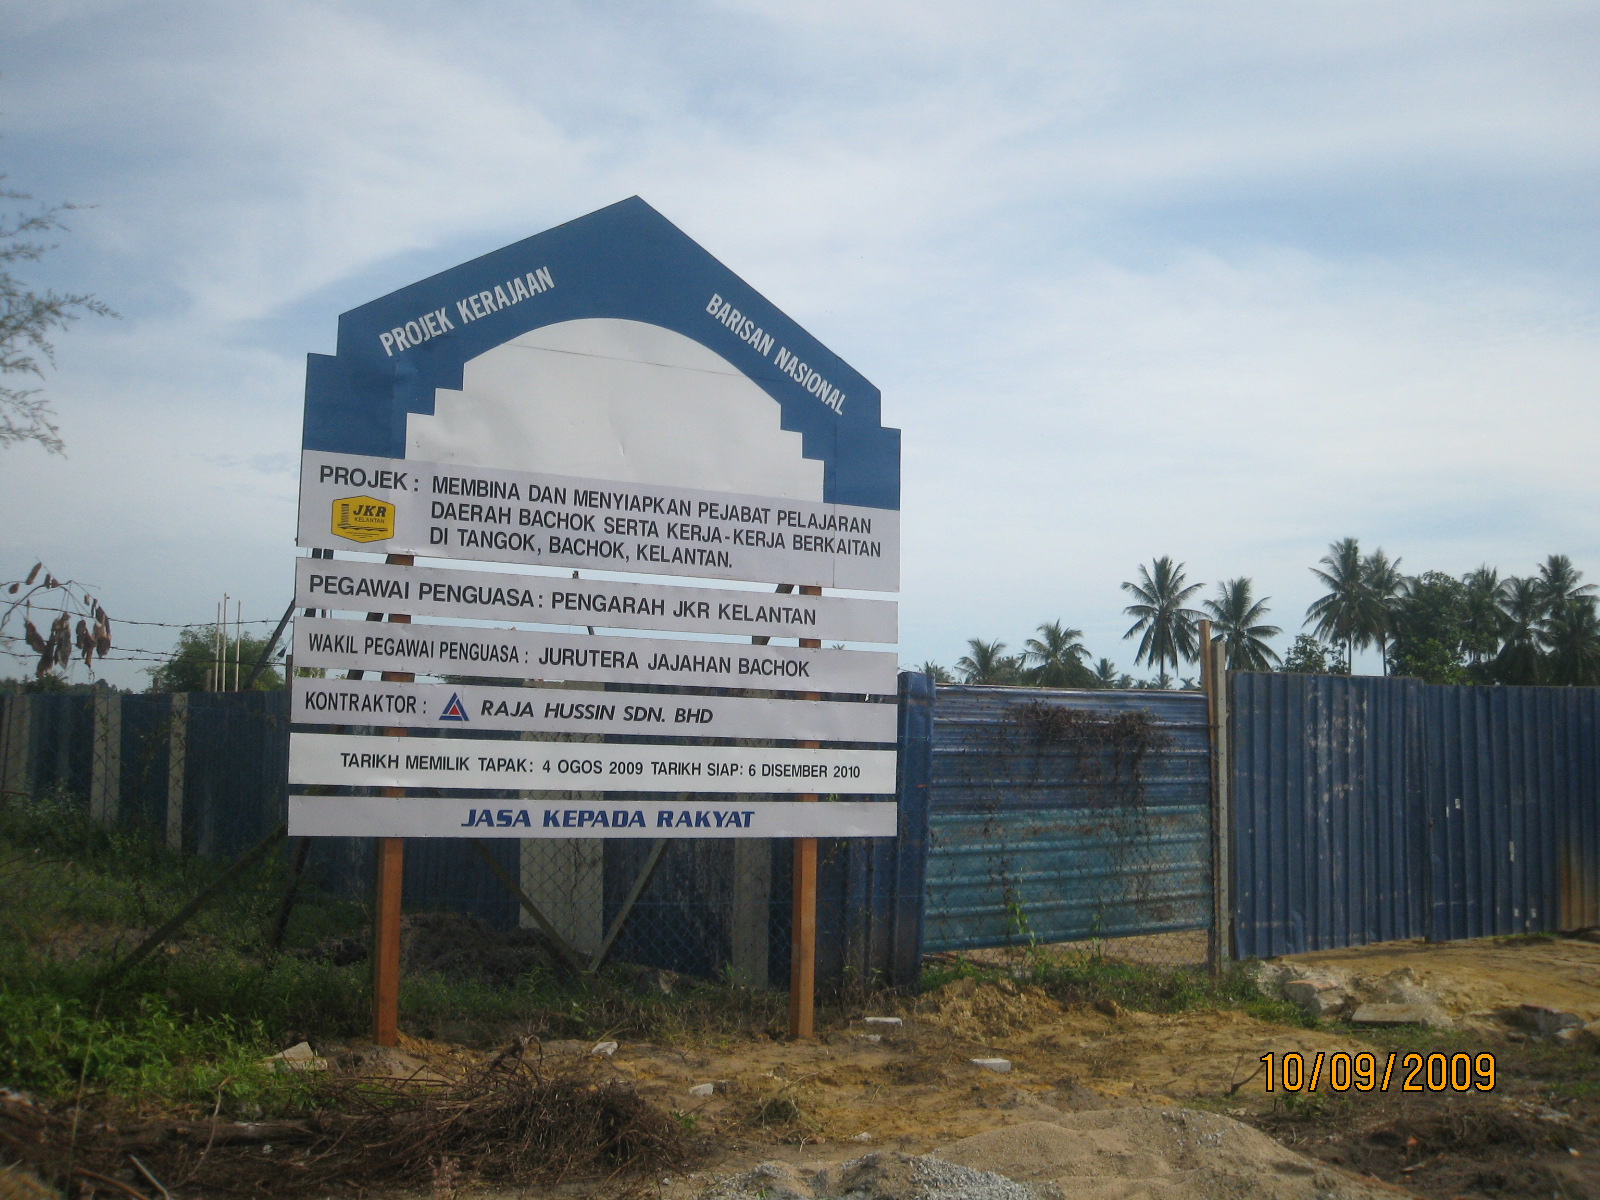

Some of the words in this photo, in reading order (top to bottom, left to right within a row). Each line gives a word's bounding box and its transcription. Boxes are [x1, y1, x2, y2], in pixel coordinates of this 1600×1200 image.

[379, 307, 454, 357] PROJEK
[456, 266, 555, 324] KERAJAAN
[706, 294, 774, 356] BARISAN
[774, 347, 845, 415] NASIONAL
[353, 505, 387, 517] JKR
[433, 476, 520, 500] MEMBINA
[529, 485, 566, 505] DAN
[574, 489, 691, 516] MENYIAPKAN
[699, 502, 771, 524] PEJABAT
[778, 510, 871, 534] PELAJARAN
[430, 527, 448, 545] DI
[457, 529, 541, 555] TANGOK,
[549, 536, 629, 563] BACHOK,
[637, 544, 732, 568] KELANTAN.
[431, 501, 511, 524] DAERAH
[519, 508, 595, 532] BACHOK
[604, 517, 659, 538] SERTA
[667, 522, 785, 549] KERJA-KERJA
[793, 534, 880, 557] BERKAITAN
[310, 575, 409, 599] PEGAWAI
[419, 583, 542, 608] PENGUASA:
[552, 592, 664, 616] PENGARAH
[673, 601, 709, 619] JKR
[719, 603, 815, 625] KELANTAN
[309, 633, 358, 654] WAKIL
[365, 637, 434, 658] PEGAWAI
[539, 647, 639, 669] JURUTERA
[648, 653, 730, 673] JAJAHAN
[739, 658, 809, 677] BACHOK
[481, 700, 534, 717] RAJA
[544, 703, 615, 720] HUSSIN
[623, 706, 665, 722] SDN.
[675, 708, 713, 723] BHD
[340, 753, 399, 769] TARIKH
[406, 755, 469, 771] MEMILIK
[478, 757, 533, 772] TAPAK:
[542, 760, 551, 773] 4
[558, 759, 602, 774] OGOS
[609, 761, 643, 775] 2009
[651, 762, 701, 775] TARIKH
[707, 763, 743, 776] SIAP:
[749, 764, 756, 776] 6
[762, 764, 827, 777] DISEMBER
[833, 766, 860, 778] 2010
[461, 809, 531, 827] JASA
[543, 810, 646, 827] KEPADA
[657, 811, 755, 827] RAKYAT
